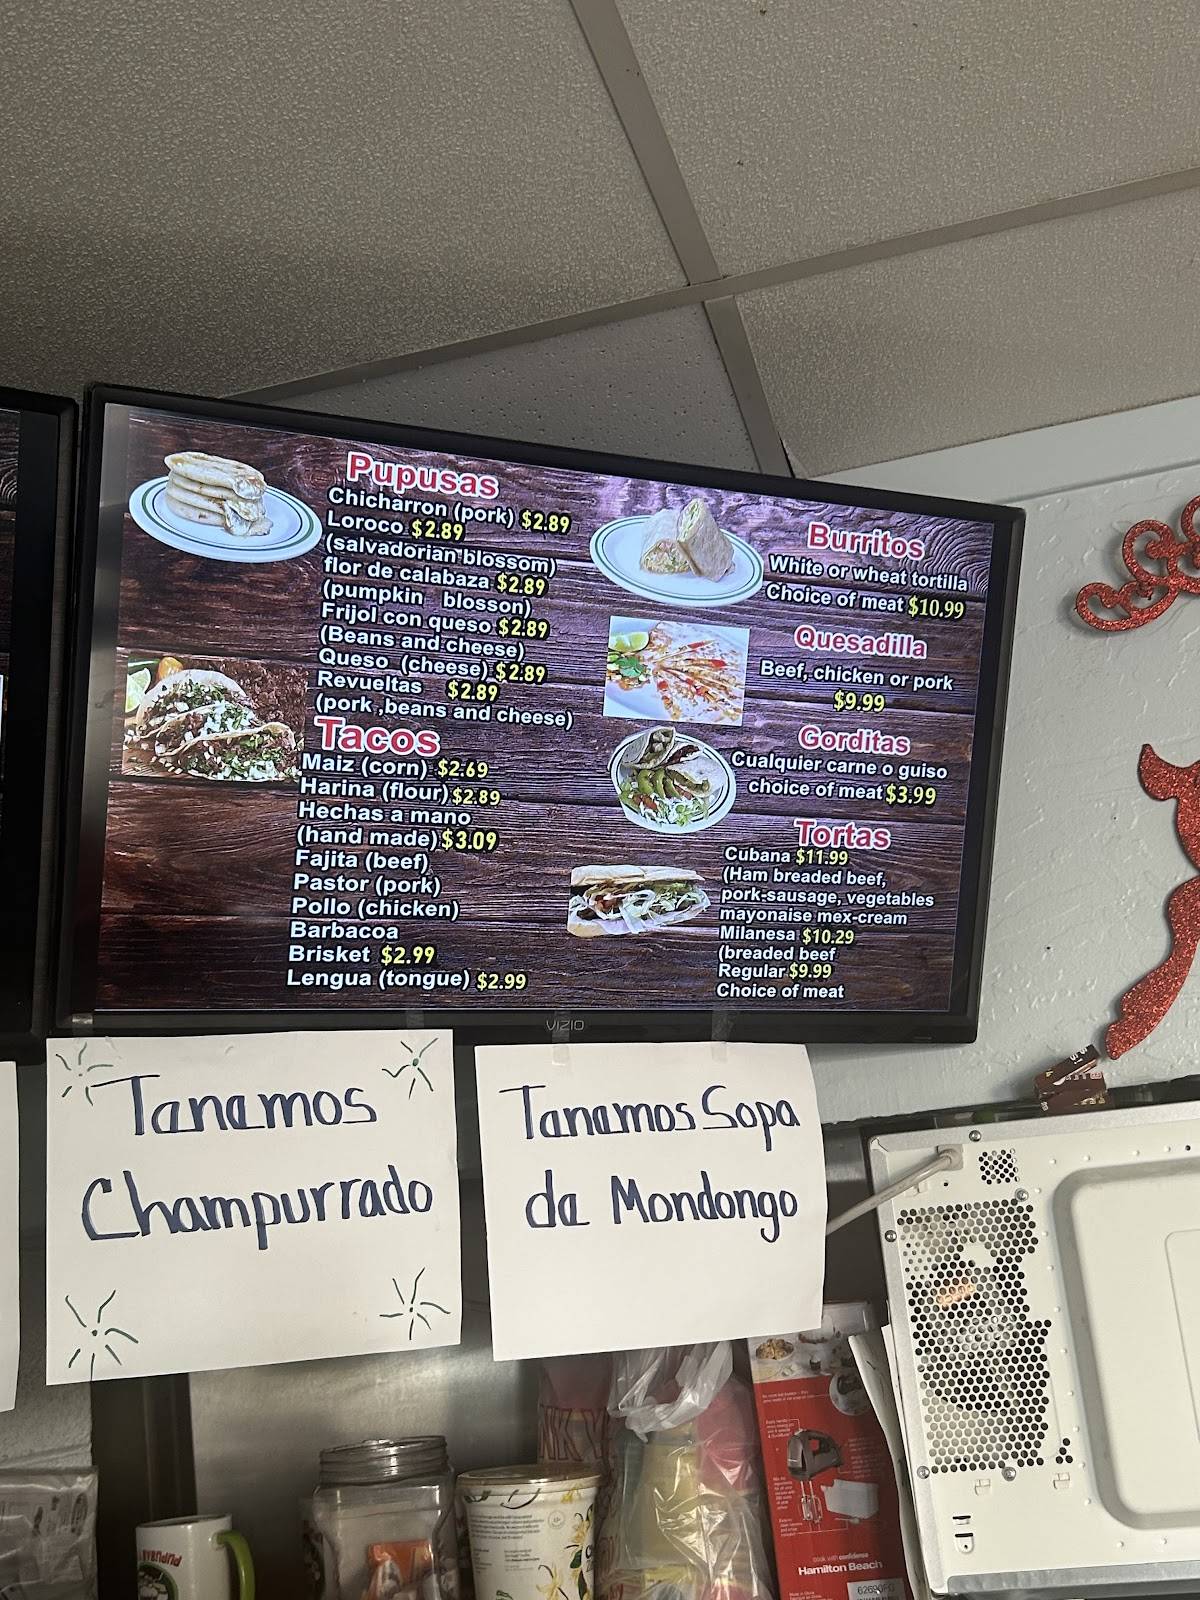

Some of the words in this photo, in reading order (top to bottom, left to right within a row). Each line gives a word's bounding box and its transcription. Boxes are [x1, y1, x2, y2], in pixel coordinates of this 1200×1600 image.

[346, 452, 499, 499] Pupusas
[328, 487, 447, 517] Chicharron
[454, 503, 515, 528] (pork)
[521, 510, 570, 533] $2.89
[327, 511, 403, 534] Loroco
[411, 519, 464, 540] $2.89
[326, 533, 456, 564] (salvadorian
[463, 548, 557, 577] blossom)
[808, 522, 924, 560] Burritos
[324, 556, 361, 576] flor
[368, 561, 393, 579] de
[400, 565, 489, 589] calabaza
[497, 572, 546, 595] $2.89
[769, 555, 823, 577] White
[828, 564, 849, 580] or
[853, 566, 906, 586] wheat
[912, 572, 968, 592] tortilla
[323, 579, 423, 606] (pumpkin
[443, 591, 531, 618] blosson)
[766, 584, 832, 606] Choice
[836, 590, 856, 608] of
[862, 595, 904, 612] meat
[908, 595, 964, 620] $10.99
[321, 602, 376, 626] Frijol
[383, 610, 422, 627] con
[429, 615, 491, 636] queso
[498, 616, 547, 638] $2.89
[320, 624, 395, 647] (Beans
[401, 633, 440, 651] and
[446, 637, 525, 661] cheese)
[794, 625, 926, 659] Quesadilla
[318, 648, 388, 669] Queso
[401, 655, 488, 678] (cheese)
[495, 662, 546, 683] $2.89
[760, 660, 808, 682] Beef,
[814, 664, 884, 686] chicken
[890, 673, 909, 688] or
[913, 674, 954, 692] pork
[317, 670, 422, 694] Revueltas
[448, 680, 498, 701] $2.89
[316, 693, 372, 714] (pork
[453, 704, 492, 721] and
[497, 706, 574, 728] cheese)
[834, 690, 885, 712] $9.99
[314, 715, 441, 757] Tacos
[798, 724, 910, 756] Gorditas
[302, 753, 354, 772] Maiz
[361, 756, 427, 780] (corn)
[437, 759, 488, 778] $2.69
[731, 752, 822, 773] Cualquier
[826, 761, 877, 776] carne
[882, 764, 893, 776] o
[898, 764, 948, 780] guiso
[301, 778, 375, 798] Harina
[382, 781, 448, 804] (flour)
[452, 788, 500, 805] $2.89
[748, 778, 810, 796] choice
[816, 782, 835, 797] of
[839, 785, 882, 800] meat
[886, 783, 936, 806] $3.99
[299, 802, 384, 821] Hechas
[391, 809, 403, 822] a
[410, 808, 471, 825] mano
[297, 826, 362, 847] (hand
[369, 829, 438, 850] made)
[441, 829, 497, 850] $3.09
[794, 818, 891, 850] Tortas
[295, 849, 358, 871] Fajita
[365, 851, 429, 873] (beef)
[725, 847, 791, 863] Cubana
[796, 850, 848, 866] $11.99
[294, 873, 369, 892] Pastor
[375, 876, 441, 898] (pork)
[722, 866, 768, 884] (Ham
[773, 868, 842, 884] breaded
[846, 871, 886, 888] beef,
[292, 898, 351, 916] Pollo
[358, 899, 460, 921] (chicken)
[722, 888, 842, 906] pork-sausage,
[847, 892, 934, 907] vegetables
[291, 922, 399, 940] Barbacoa
[720, 910, 812, 924] mayonaise
[817, 910, 907, 925] mex-cream
[720, 926, 795, 941] Milanesa
[802, 928, 854, 944] $10.29
[289, 945, 370, 963] Brisket
[380, 945, 435, 965] $2.99
[718, 945, 794, 962] (breaded
[800, 946, 836, 961] beef
[287, 969, 371, 990] Lengua
[378, 969, 470, 991] (tongue)
[476, 973, 527, 991] $2.99
[718, 964, 786, 980] Regular
[790, 964, 832, 978] $9.99
[716, 983, 778, 998] Choice
[782, 984, 800, 998] of
[804, 984, 844, 998] meat
[547, 1020, 584, 1030] VIZIO
[702, 1083, 800, 1151] Sopa
[81, 1164, 434, 1250] Champurrado
[612, 1169, 798, 1243] Mondongo
[798, 1563, 847, 1576] Hamilton
[849, 1560, 883, 1570] Beach
